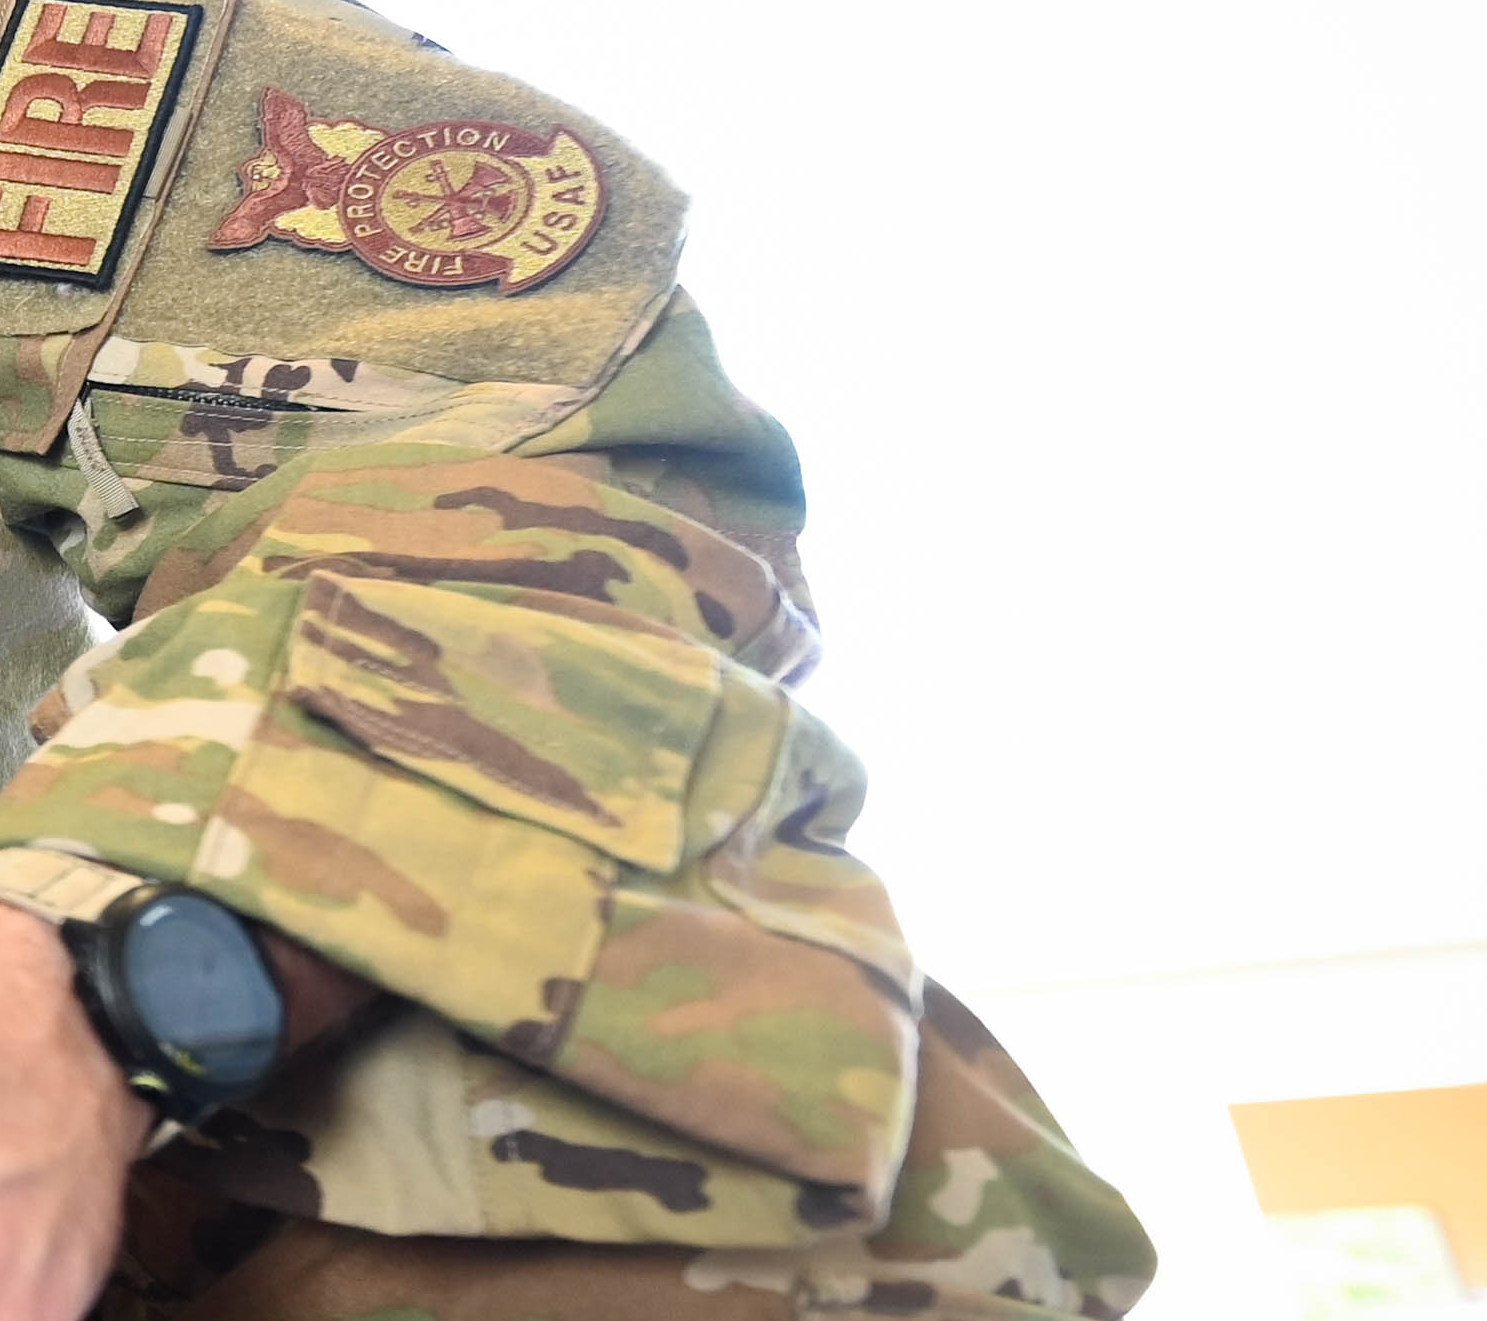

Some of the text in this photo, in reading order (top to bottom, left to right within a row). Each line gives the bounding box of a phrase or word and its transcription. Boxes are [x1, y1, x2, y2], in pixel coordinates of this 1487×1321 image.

[346, 127, 511, 276] FIRE PROTECTION
[520, 165, 585, 256] USAF
